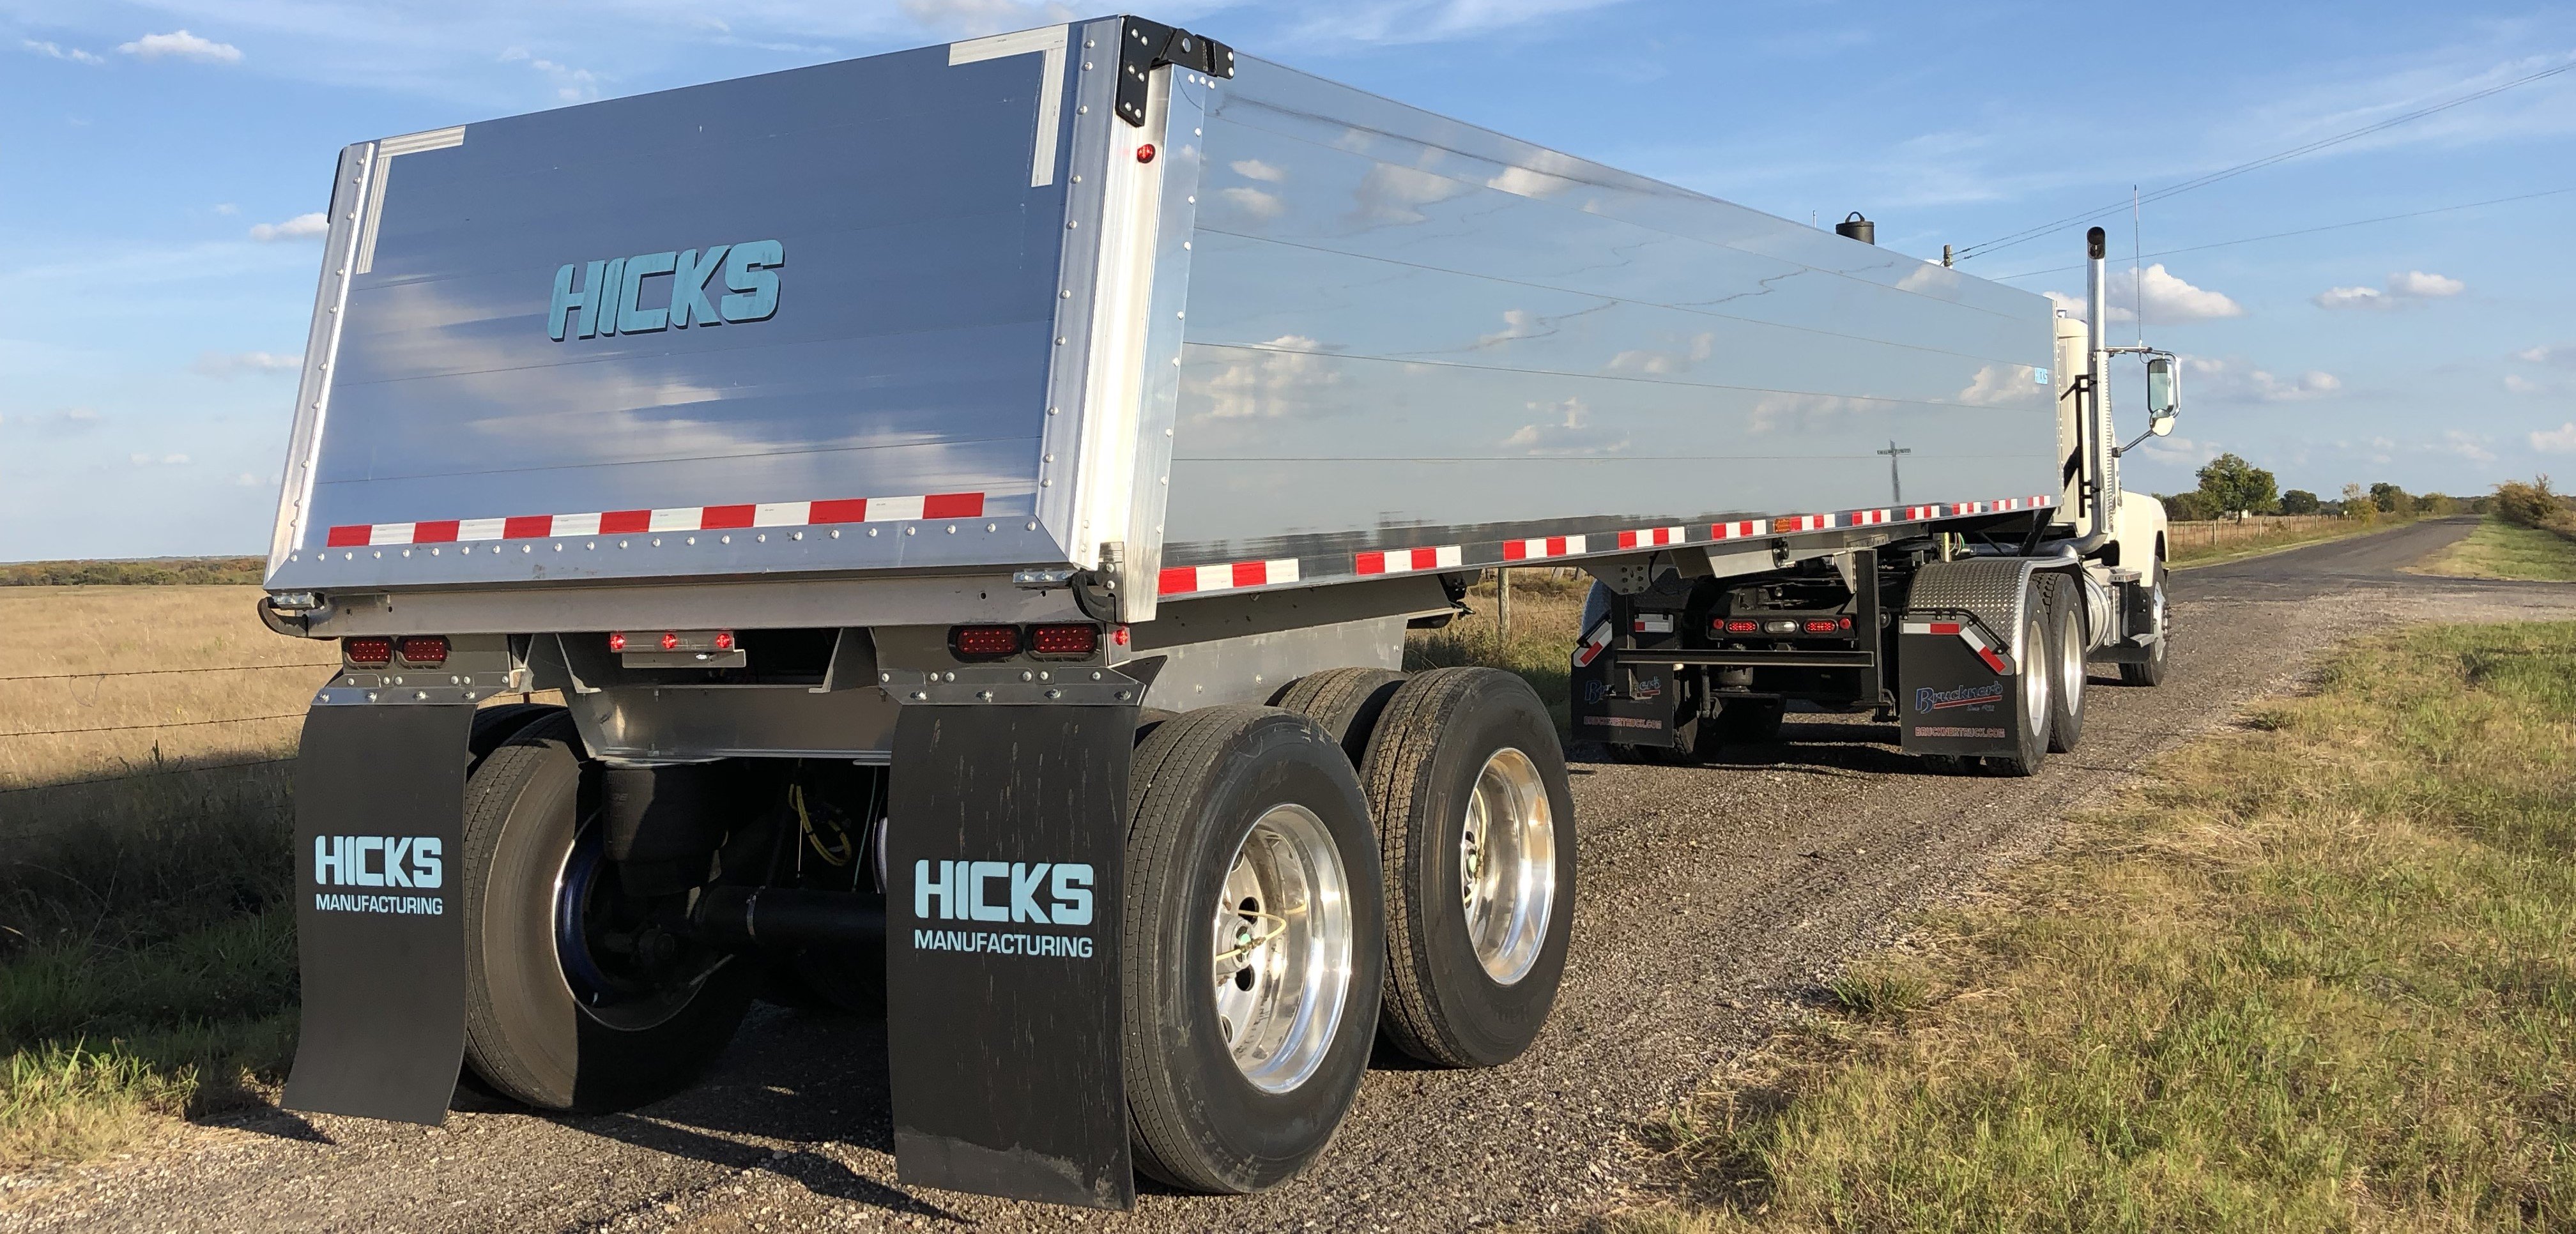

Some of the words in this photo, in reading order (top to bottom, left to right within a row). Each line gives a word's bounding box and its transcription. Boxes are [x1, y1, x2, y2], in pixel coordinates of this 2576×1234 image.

[548, 240, 785, 342] HICKS
[1915, 727, 2005, 738] BRUCKNERTRUCK.COM
[316, 835, 441, 888] HICKS
[316, 894, 443, 915] MANUFACTURING
[915, 860, 1094, 925] HICKS
[915, 929, 1093, 958] MANUFACTURING
